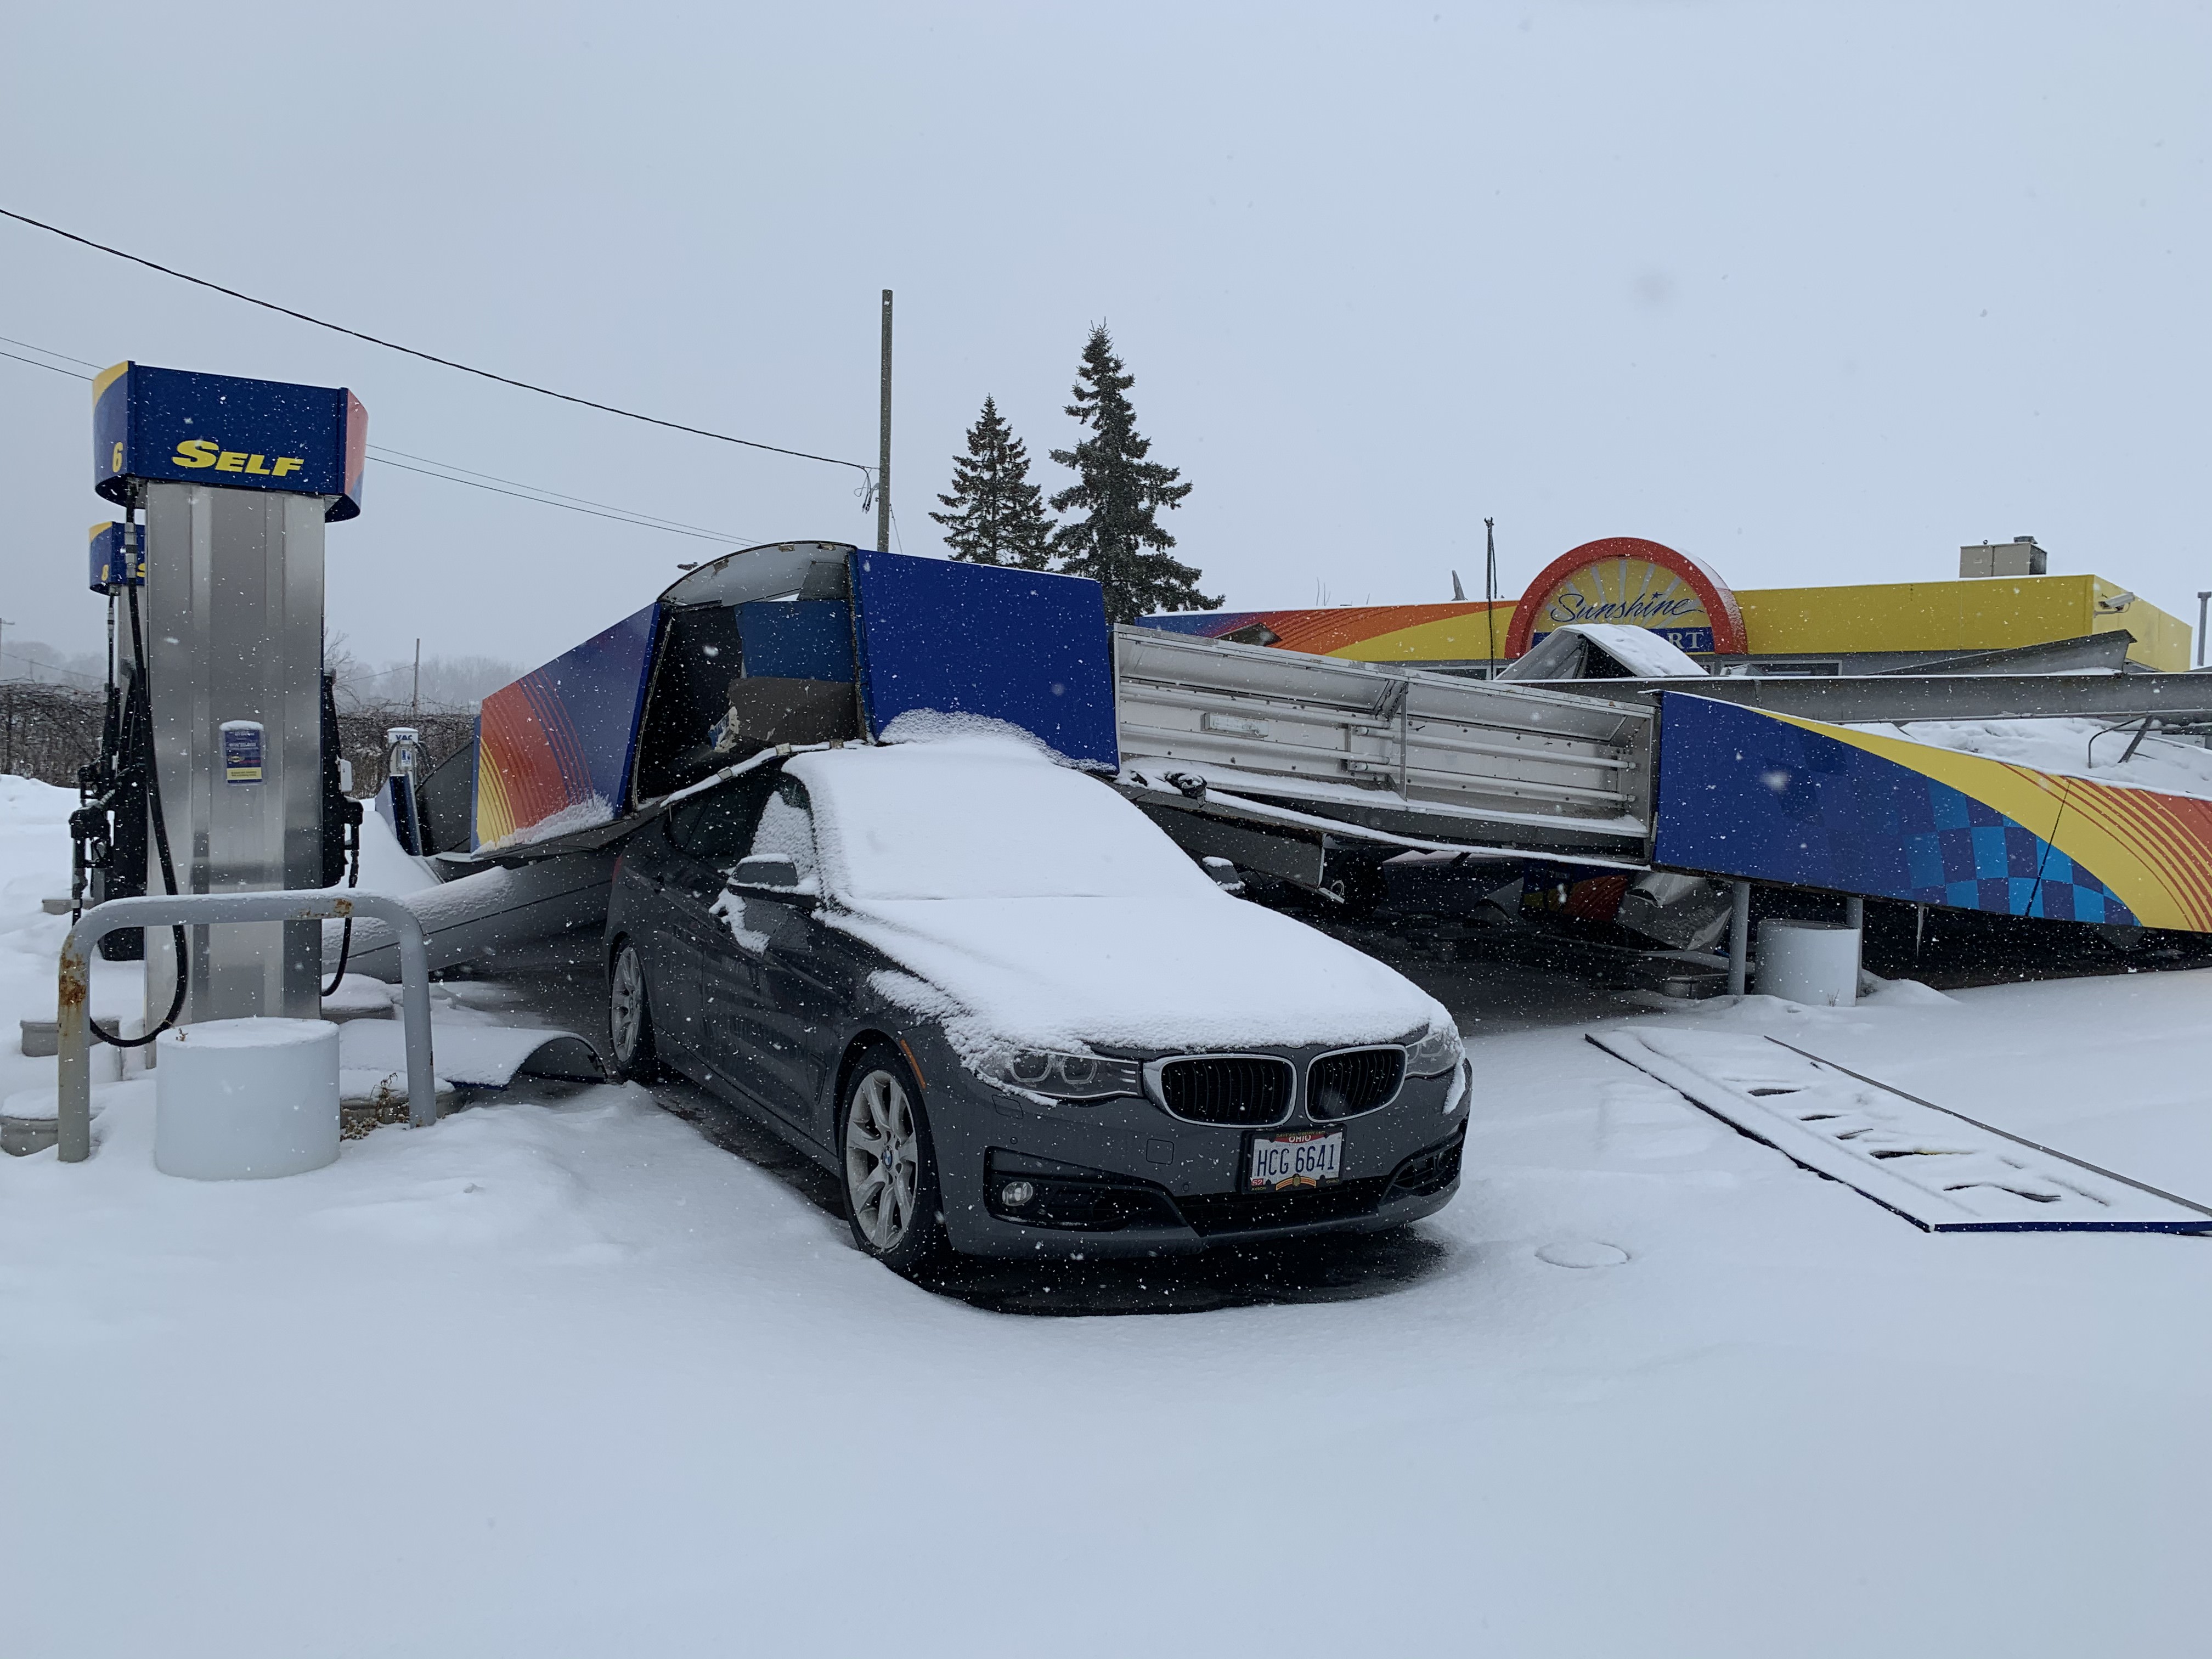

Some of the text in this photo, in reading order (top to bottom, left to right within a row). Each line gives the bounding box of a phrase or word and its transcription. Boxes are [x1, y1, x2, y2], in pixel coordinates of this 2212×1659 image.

[112, 442, 123, 473] 6
[101, 564, 109, 582] 8
[1550, 591, 1705, 622] Sunshine
[1666, 631, 1705, 649] RT
[1288, 1135, 1312, 1143] OHIO
[1257, 1144, 1334, 1177] HCG 6641
